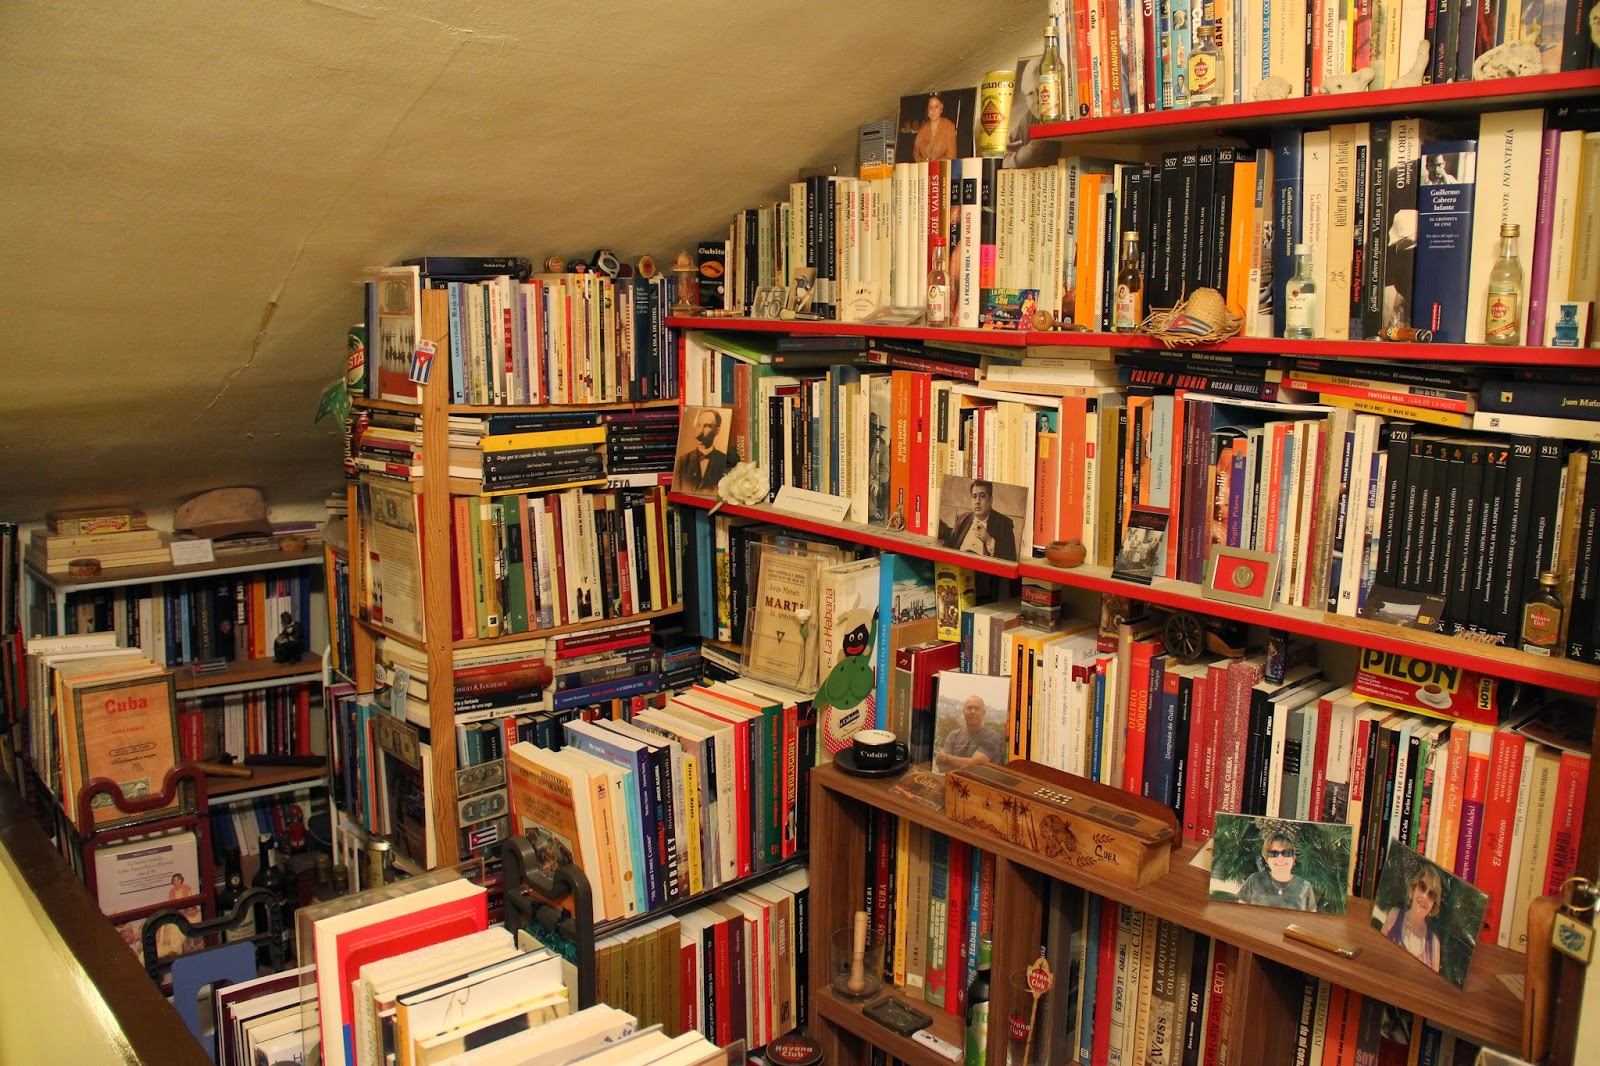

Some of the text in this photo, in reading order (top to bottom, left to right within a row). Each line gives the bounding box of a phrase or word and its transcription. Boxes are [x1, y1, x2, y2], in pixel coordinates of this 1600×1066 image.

[1204, 2, 1214, 21] CUBA
[1262, 16, 1271, 58] MANUAL DEL
[1325, 17, 1335, 67] cocina cubana
[1436, 42, 1446, 79] Amir Valle
[1165, 157, 1177, 168] 357
[1183, 155, 1196, 164] 428
[1200, 154, 1213, 164] 463
[1219, 151, 1232, 160] 165
[1396, 124, 1407, 189] PURO HUMO
[1501, 128, 1514, 188] INFANTERÍA
[1008, 173, 1016, 196] Habana
[1334, 140, 1349, 227] Guillermo Cabrera Infante
[1430, 189, 1460, 197] Guillermo
[931, 174, 939, 235] ZOÉ VALDÉS
[1066, 165, 1078, 236] Corazón mestizo
[1432, 196, 1457, 204] Cabrera
[998, 235, 1006, 260] Trilogía
[1371, 158, 1383, 313] Guillermo Cabrera Infante Vidas para leerlas
[699, 247, 725, 256] Cubita
[1252, 247, 1260, 269] sombra
[1353, 249, 1363, 302] Cabrera Infante
[1131, 369, 1233, 391] VOLVER A MORIR ROSANA
[1562, 397, 1577, 407] Juan
[1390, 431, 1407, 440] 470
[1440, 448, 1447, 459] 3
[1514, 444, 1531, 454] 700
[1542, 446, 1557, 455] 813
[1304, 447, 1314, 488] CUBANAS
[607, 478, 631, 488] ZETA
[1214, 471, 1227, 506] Virgilio
[1368, 484, 1377, 507] caballos
[1231, 494, 1240, 547] Virgilio Piñera
[1336, 494, 1348, 540] leonardo padura
[1491, 497, 1500, 525] SERPIENTE
[1506, 477, 1522, 569] HOMBRE PERROS
[1463, 524, 1471, 548] NEBLINA
[768, 583, 782, 592] Jorge
[1025, 590, 1048, 601] Popular
[824, 588, 833, 655] La Habana
[1530, 614, 1550, 622] Havana
[1363, 648, 1458, 690] PILON
[103, 696, 148, 714] Cuba
[1480, 679, 1491, 709] PILON
[1128, 689, 1138, 729] DELIRIO
[1136, 690, 1148, 733] NÓRDICO
[1165, 705, 1175, 760] Después Cuba
[861, 750, 888, 759] Cubita
[913, 772, 937, 789] Cuba
[1222, 757, 1233, 811] ZONA GUERRA
[1405, 778, 1413, 799] Fuentes
[1394, 793, 1402, 818] MARIEL
[1466, 805, 1476, 827] Madrid
[1495, 819, 1507, 858] desencanto
[667, 837, 679, 896] CUBATEY
[1551, 831, 1570, 889] DEL MAMBO
[878, 884, 886, 909] CUBA
[967, 921, 978, 957] Habana
[1129, 910, 1142, 985] SENTIR CUBA
[1118, 943, 1127, 972] THIERRY
[1028, 969, 1052, 982] Havana
[1166, 946, 1176, 996] COLONIAL
[1031, 980, 1046, 990] Club
[1156, 980, 1164, 992] LA
[1178, 973, 1187, 1013] FOTOGRAFÍA
[1190, 992, 1199, 1013] RON
[1300, 995, 1312, 1024] Habana
[775, 1045, 813, 1053] Havana
[1150, 1017, 1167, 1057] Weiss
[1314, 1027, 1323, 1047] LAM
[1356, 1049, 1375, 1062] SOY
